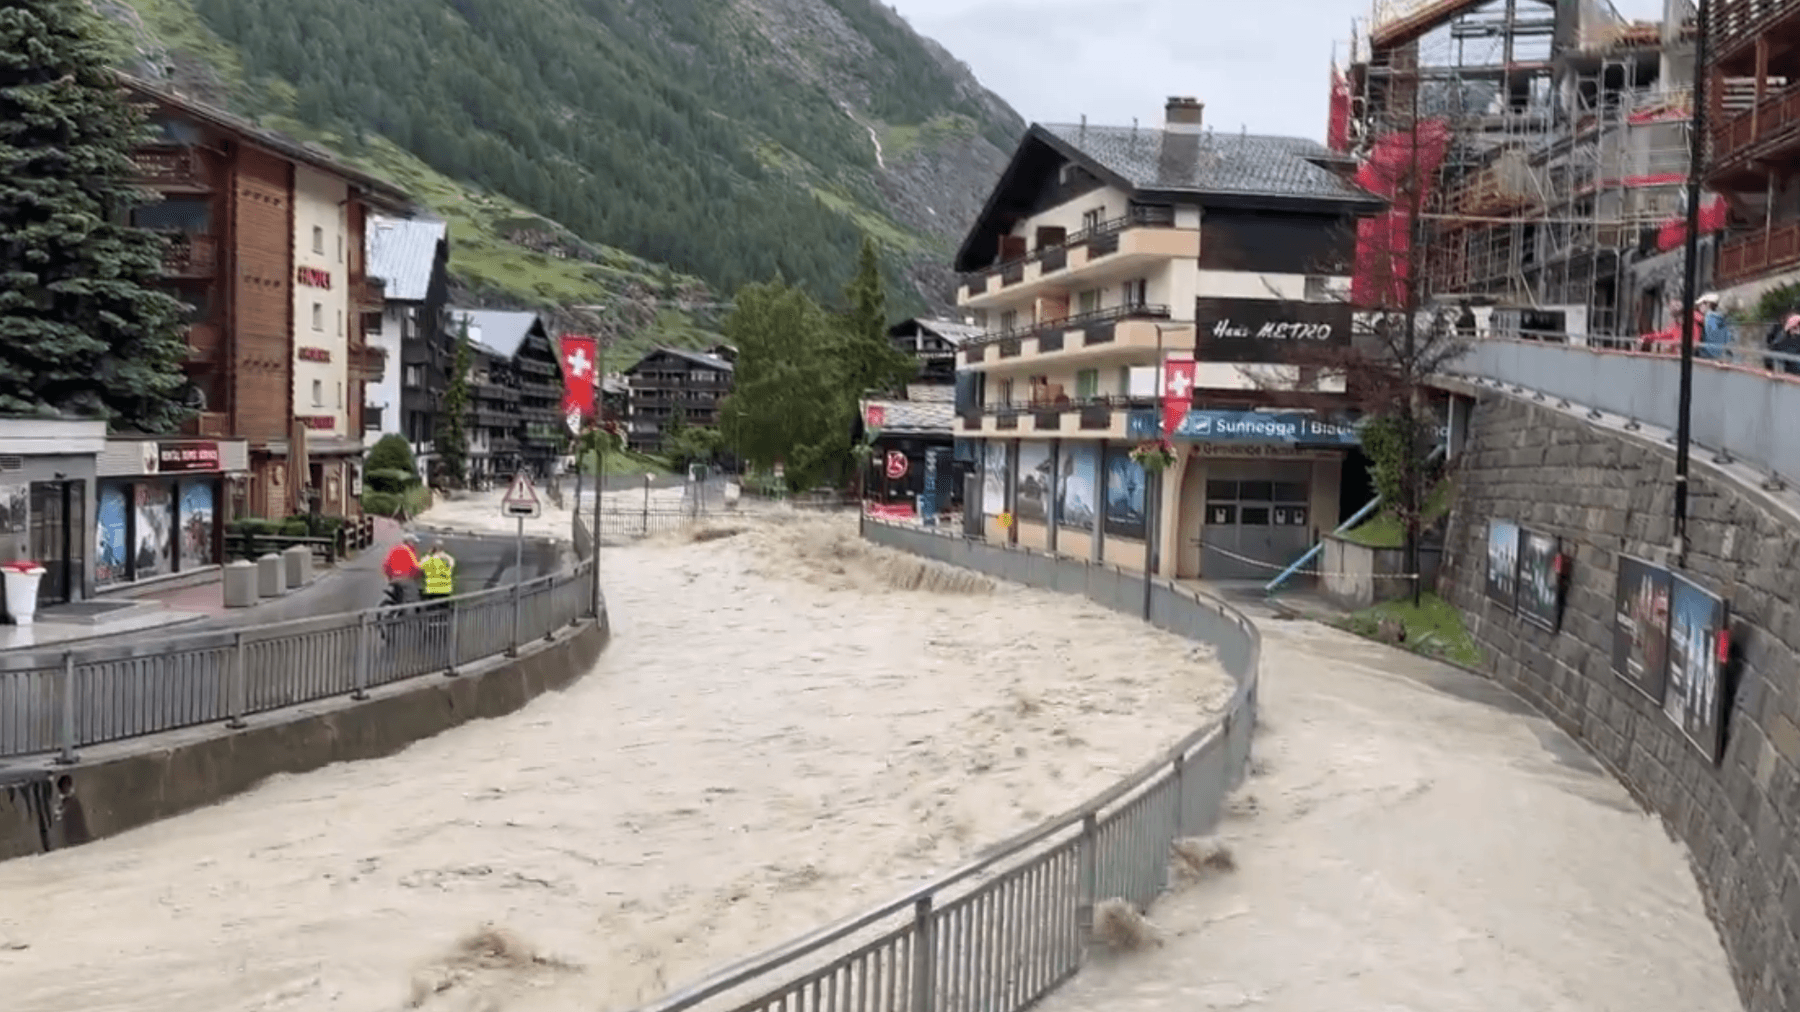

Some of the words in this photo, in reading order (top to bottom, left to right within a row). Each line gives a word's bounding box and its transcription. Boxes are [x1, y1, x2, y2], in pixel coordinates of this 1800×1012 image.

[297, 265, 332, 291] HOTEL
[1212, 318, 1248, 339] Haus
[1255, 320, 1332, 342] METRO
[1215, 418, 1297, 437] Sunnegga
